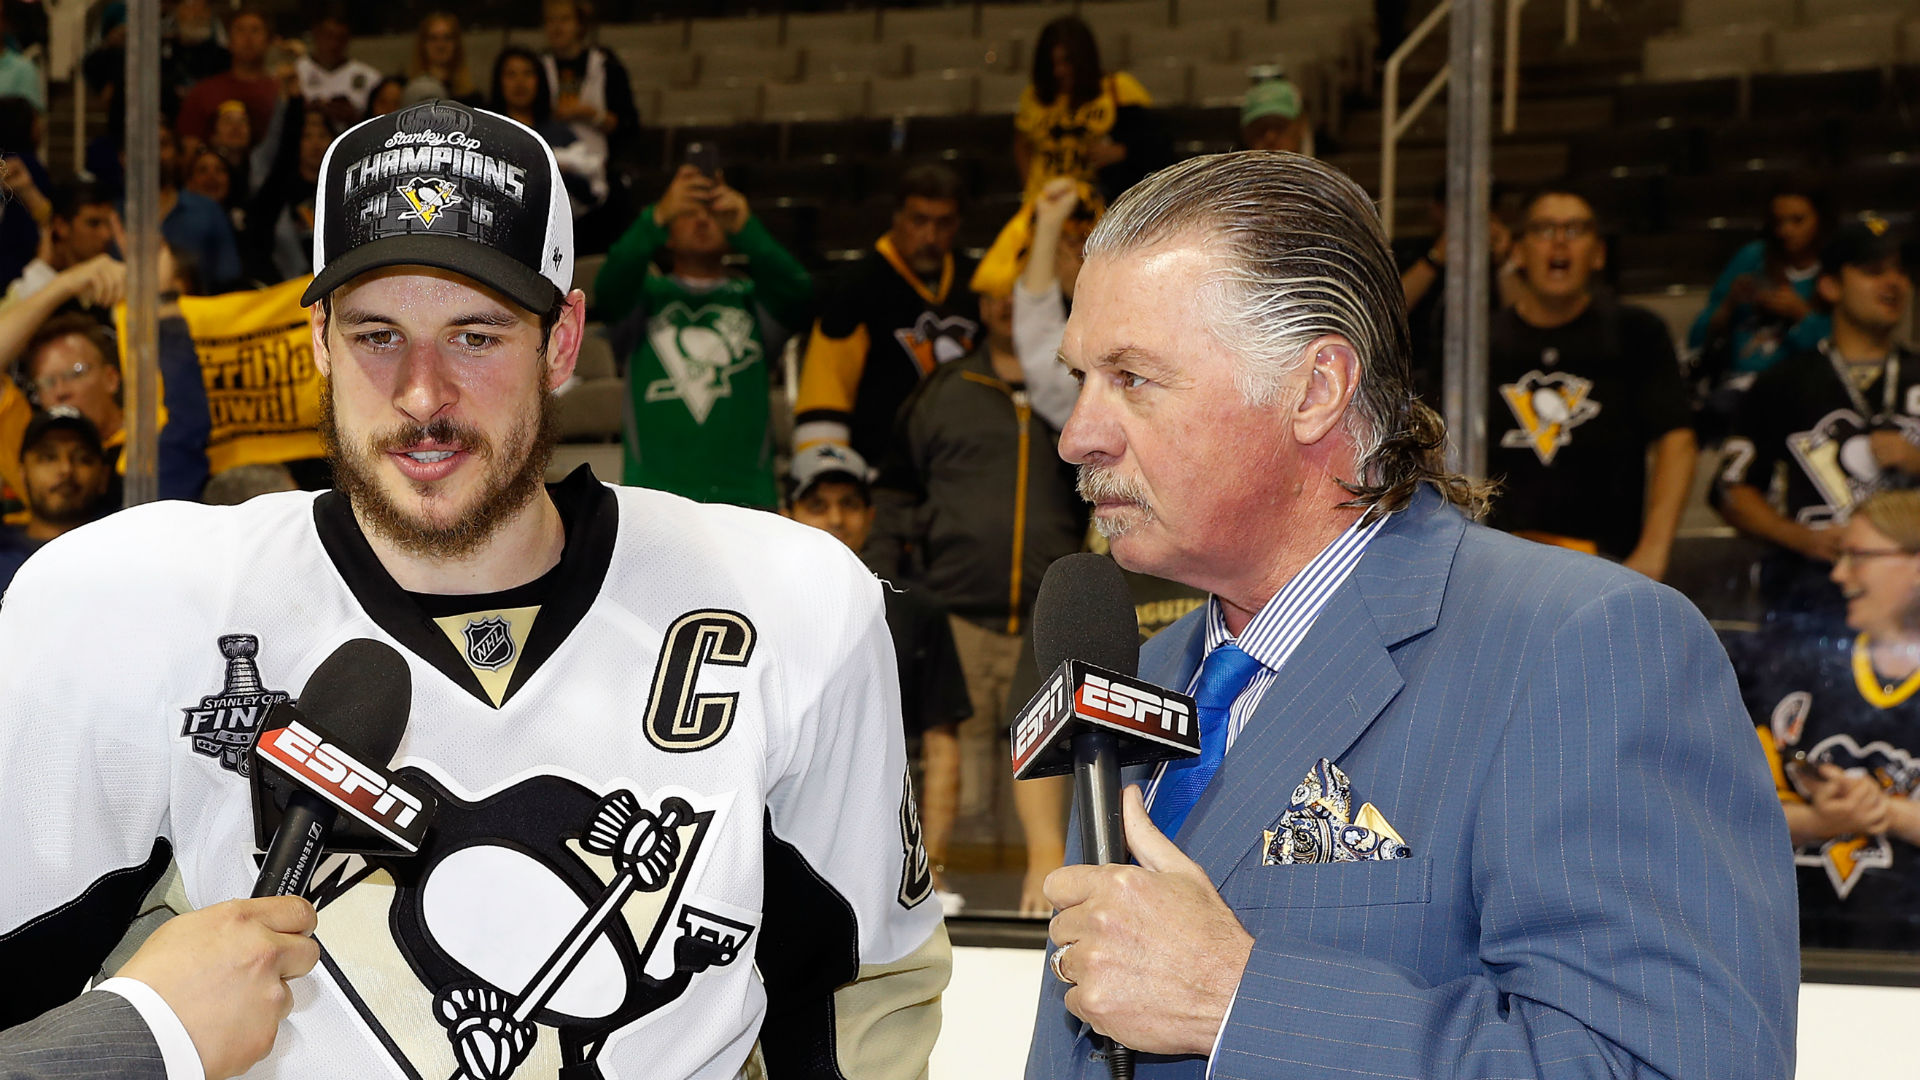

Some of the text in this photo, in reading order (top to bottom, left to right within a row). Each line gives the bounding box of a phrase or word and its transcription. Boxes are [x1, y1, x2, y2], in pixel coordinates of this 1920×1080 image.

[384, 129, 481, 151] Stanley Cup
[344, 147, 527, 204] CHAMPIONS
[471, 195, 495, 227] 16
[202, 337, 317, 390] rrible
[476, 628, 503, 661] NHL
[203, 696, 259, 710] STANLEY
[642, 608, 757, 753] C
[1082, 673, 1189, 736] ESPN
[189, 707, 258, 733] FIN
[1016, 674, 1064, 761] ESPN
[273, 720, 423, 829] ESPN
[285, 840, 314, 896] SENNHEIS
